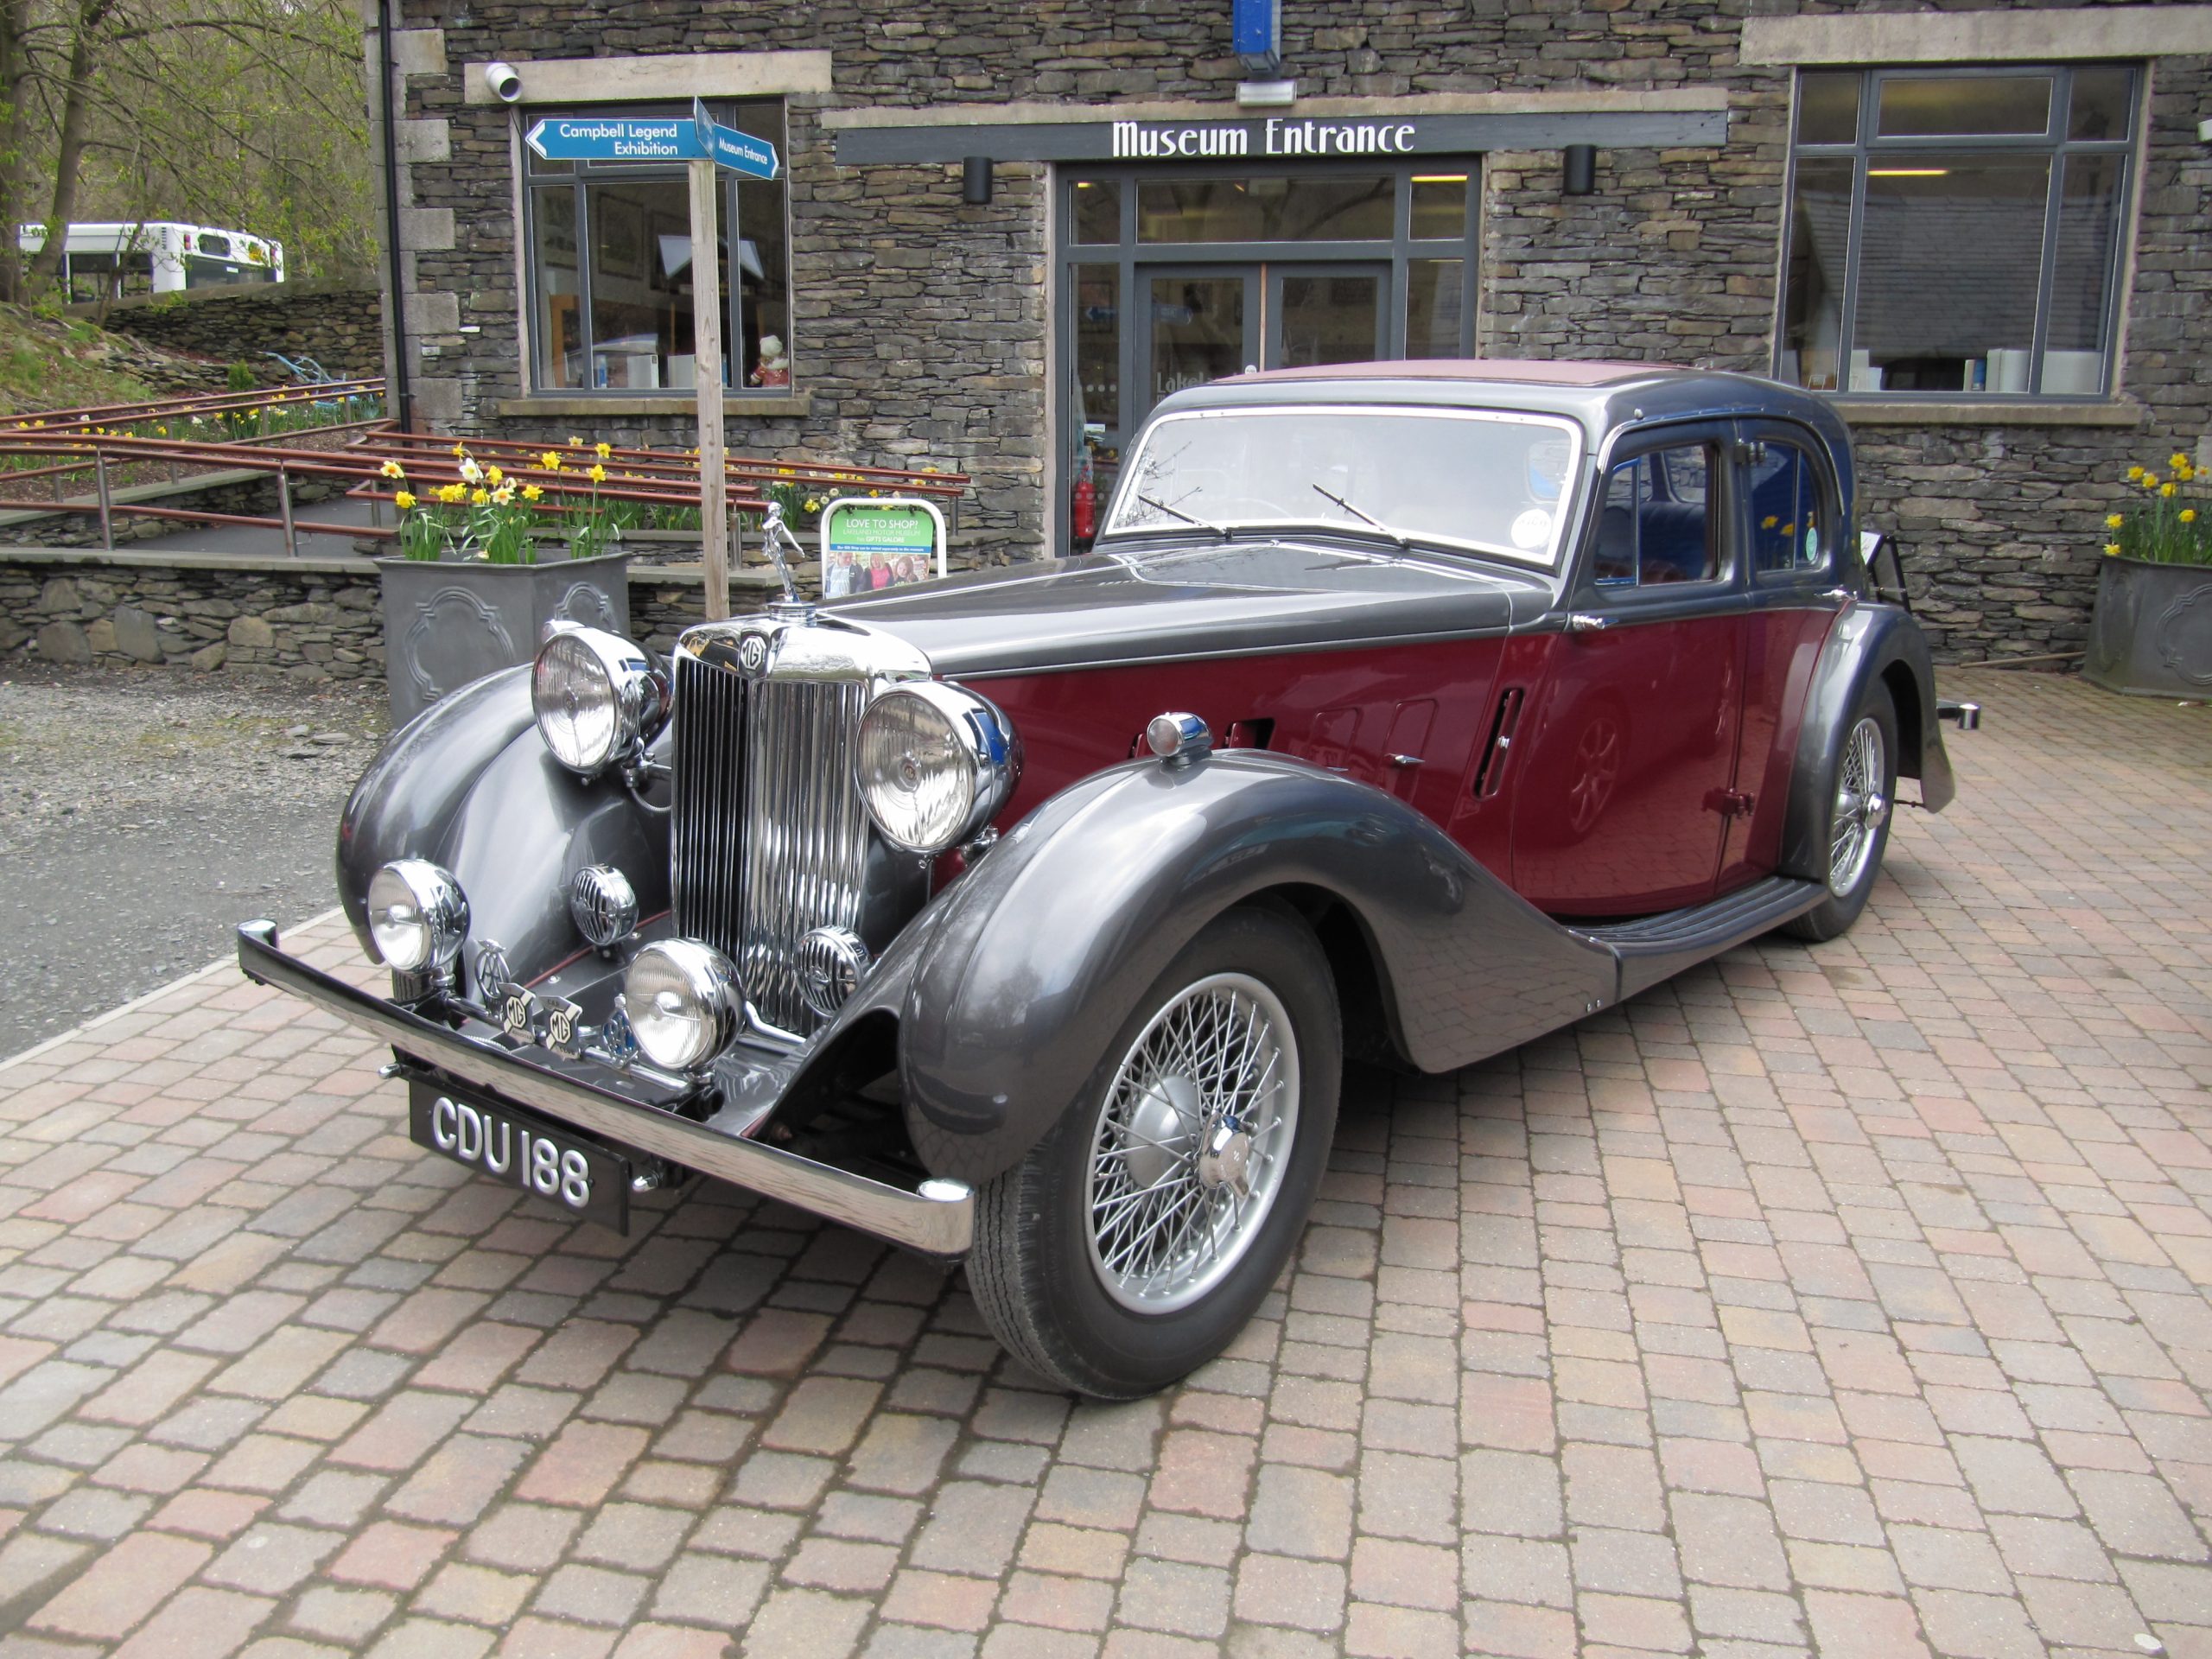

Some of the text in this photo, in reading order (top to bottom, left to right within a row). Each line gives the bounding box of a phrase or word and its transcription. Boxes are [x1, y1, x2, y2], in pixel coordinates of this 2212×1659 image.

[560, 124, 677, 141] Campbell Legend
[1113, 118, 1415, 157] Museum Entrance
[614, 142, 678, 156] Exhibition
[718, 137, 768, 165] Museum Entrance
[846, 518, 918, 529] LOVE TO SHOP?
[742, 640, 760, 667] MG
[507, 999, 524, 1027] MG
[551, 1014, 569, 1042] MG
[432, 1096, 590, 1208] CDU 188
